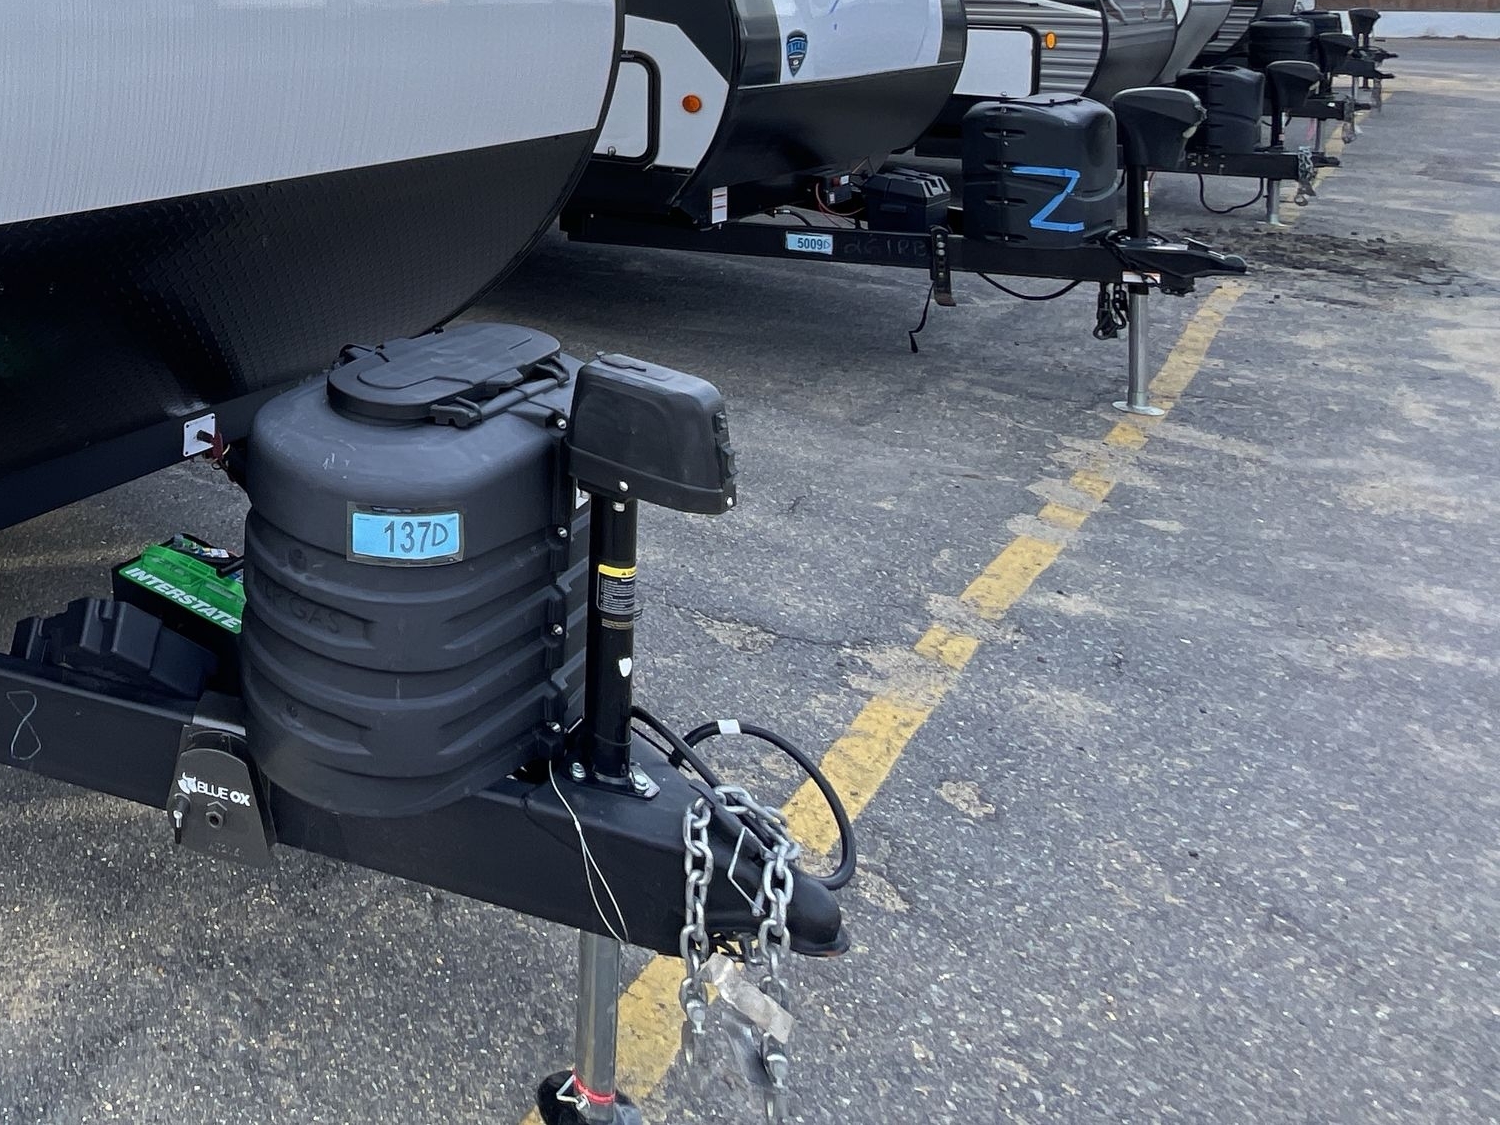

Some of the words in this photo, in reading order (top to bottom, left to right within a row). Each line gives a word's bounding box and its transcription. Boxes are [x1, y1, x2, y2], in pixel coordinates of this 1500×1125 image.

[383, 520, 449, 554] 137D
[124, 567, 242, 628] INTERSTATE
[196, 780, 229, 801] BLUE
[229, 790, 251, 807] OX
